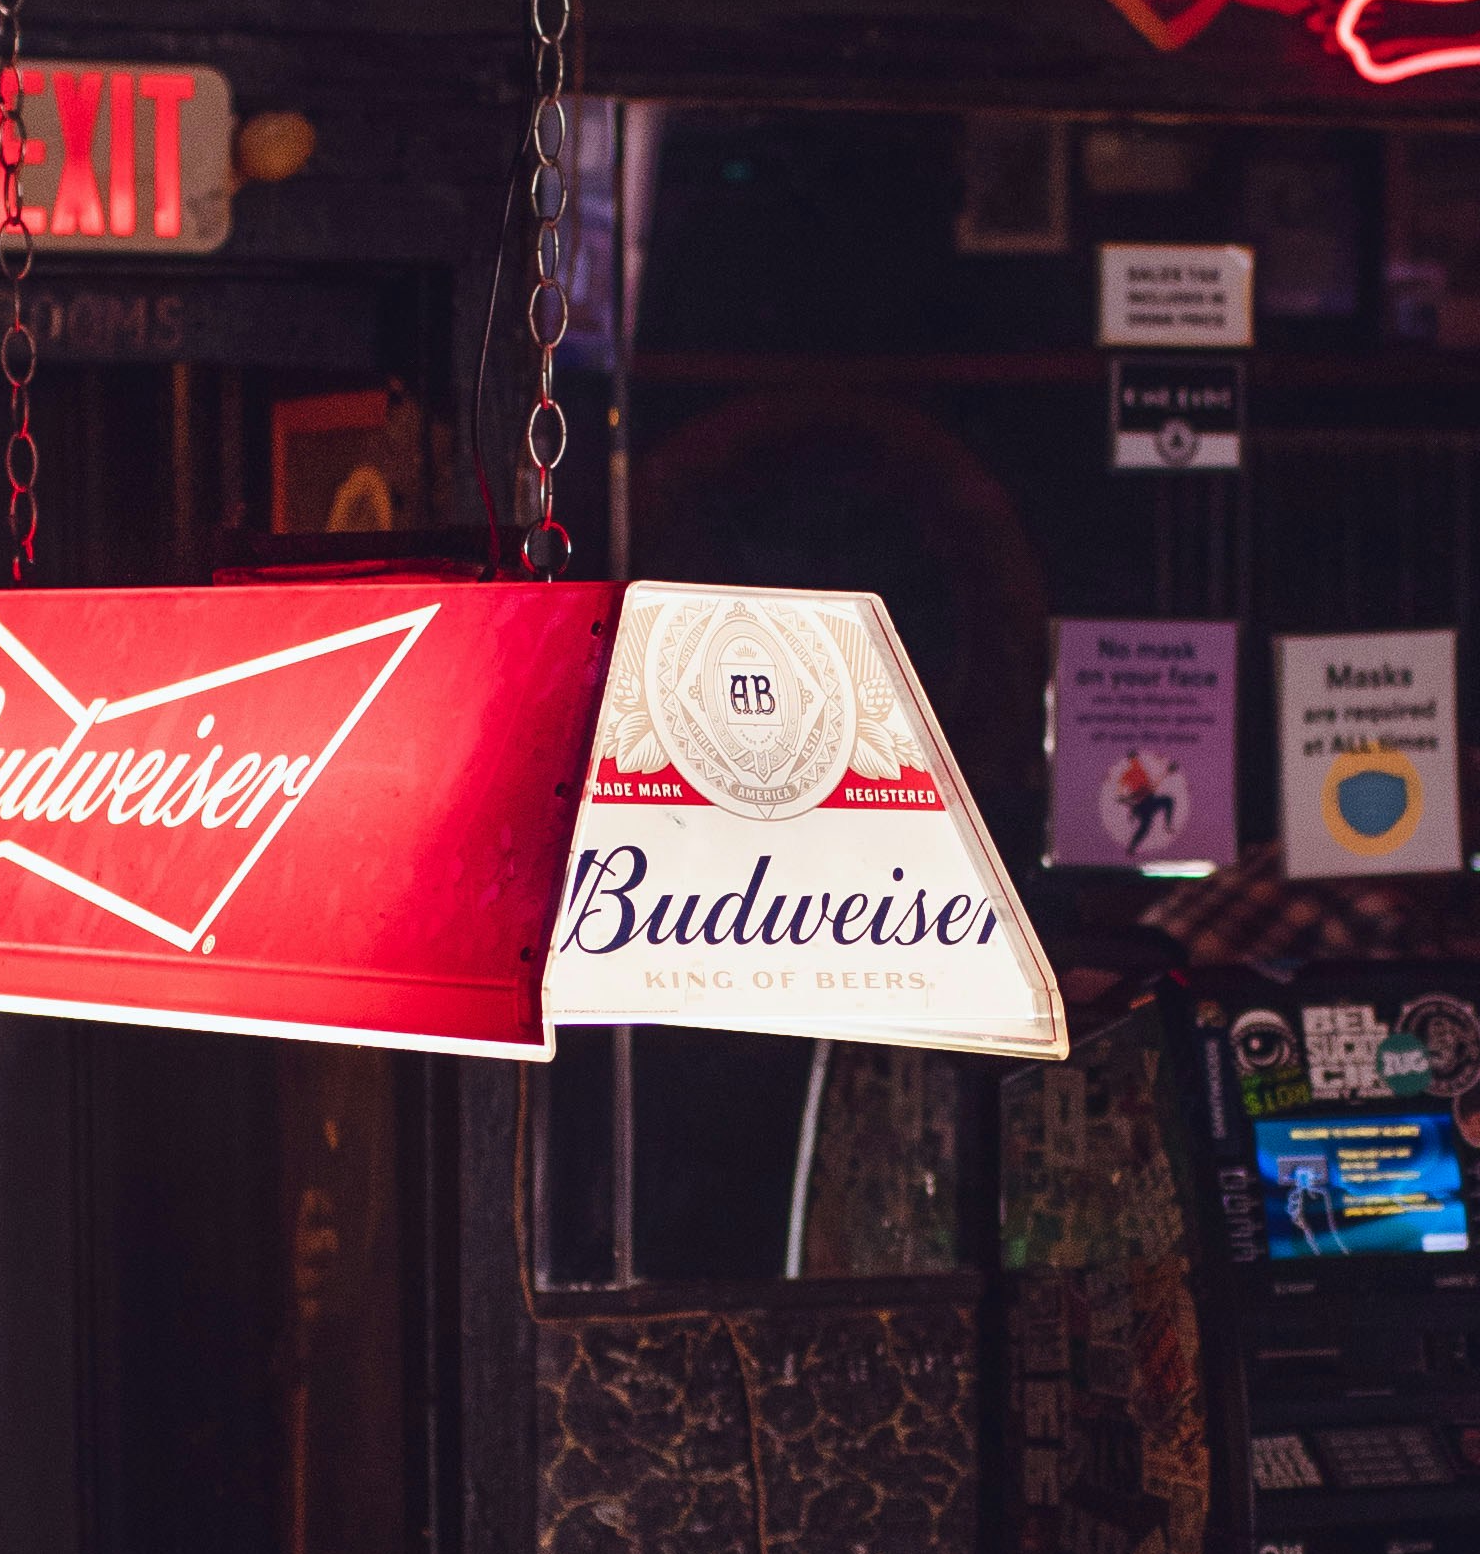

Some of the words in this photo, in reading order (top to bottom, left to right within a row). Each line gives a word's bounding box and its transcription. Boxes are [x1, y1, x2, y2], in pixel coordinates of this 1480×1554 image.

[1099, 638, 1131, 659] No
[1326, 663, 1413, 688] Masks
[730, 674, 776, 715] AB
[1304, 708, 1336, 725] are
[1344, 697, 1437, 725] required
[688, 720, 719, 760] AFRICA
[801, 728, 821, 760] ASIA
[1303, 737, 1324, 758] at
[1331, 734, 1372, 755] ALL
[1378, 732, 1438, 752] times
[592, 781, 634, 798] RADE
[638, 782, 684, 799] MARK
[737, 786, 791, 801] AMERICA
[845, 787, 936, 805] REGISTERED
[644, 969, 734, 990] KING
[752, 970, 800, 989] OF
